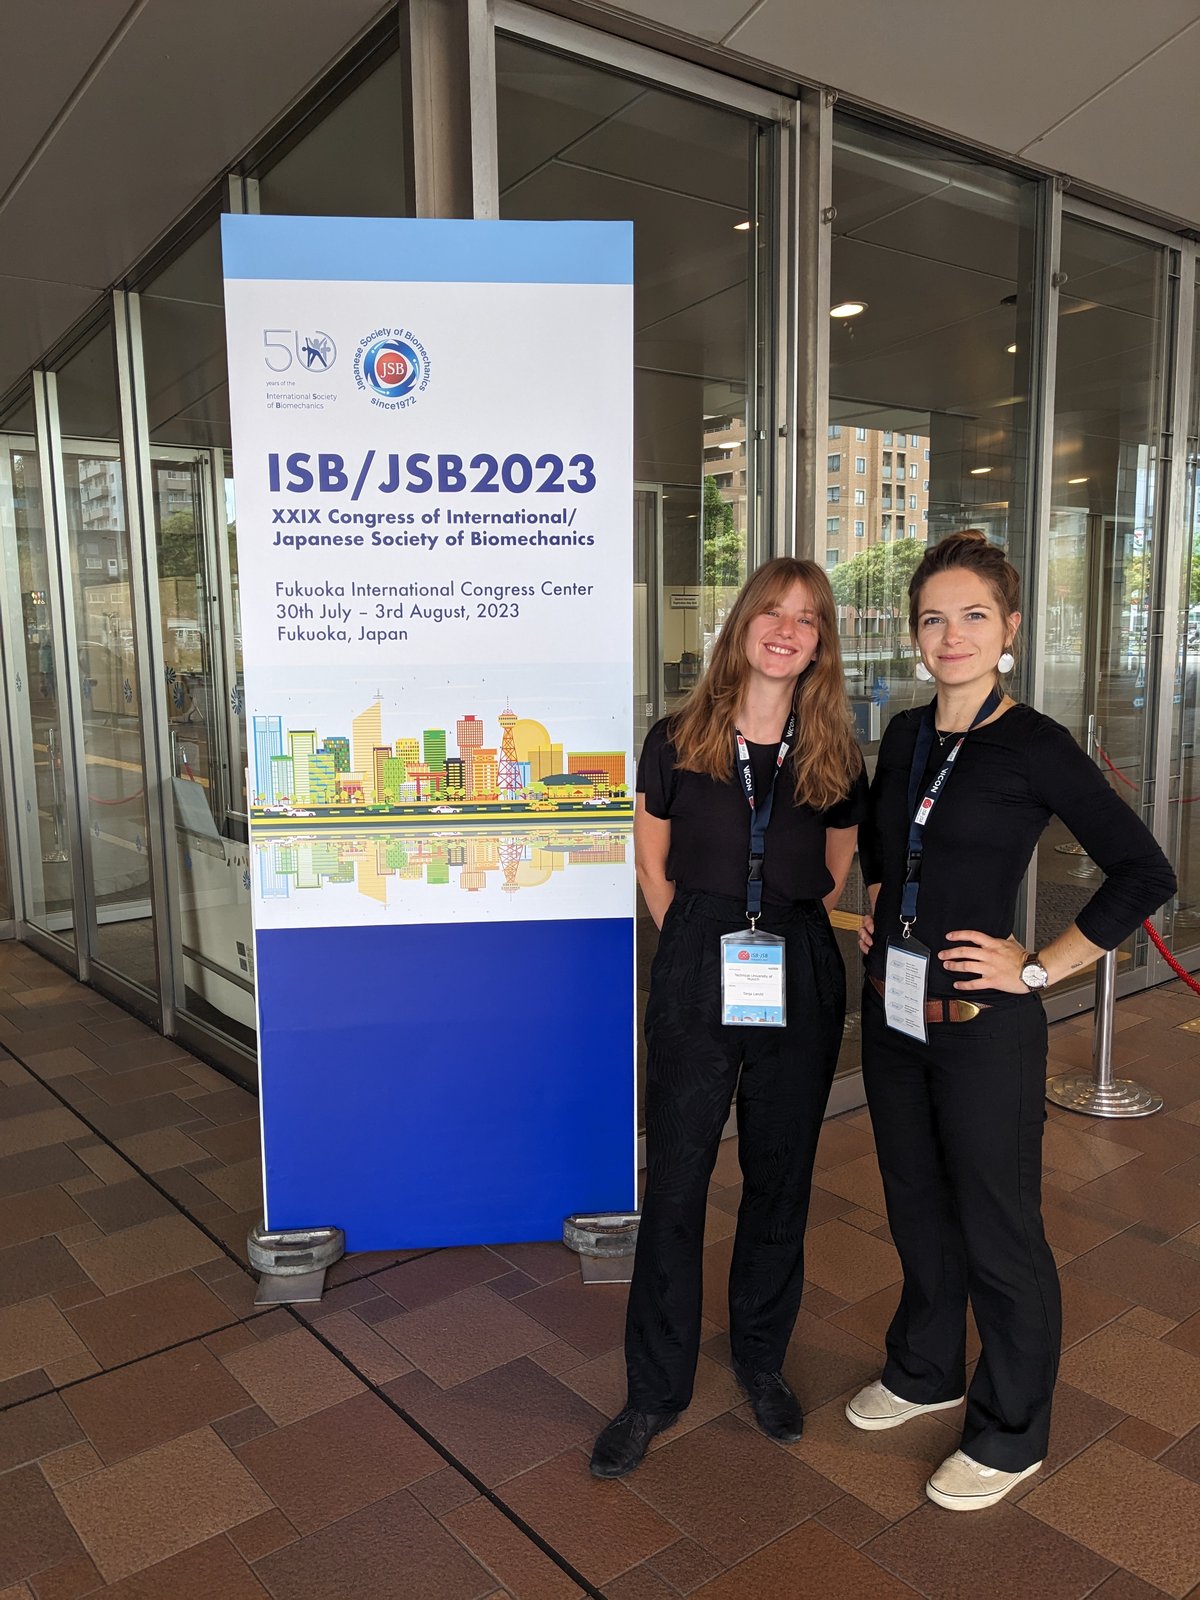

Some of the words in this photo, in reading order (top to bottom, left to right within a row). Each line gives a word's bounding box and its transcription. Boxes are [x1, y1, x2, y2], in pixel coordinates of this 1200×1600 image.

[353, 347, 366, 391] Japanese
[360, 328, 391, 347] Society
[394, 328, 403, 336] of
[404, 330, 432, 392] Biomechanics
[381, 362, 405, 378] JSB
[266, 392, 311, 400] International
[312, 392, 338, 401] Society
[275, 402, 324, 410] Biomechanics
[370, 395, 417, 410] since1972
[268, 450, 597, 501] ISB/JSB2023
[272, 509, 321, 524] XXIX
[328, 508, 415, 529] Congress
[421, 508, 441, 524] of
[447, 508, 577, 526] International/
[272, 531, 364, 550] Japanese
[371, 530, 439, 551] Society
[445, 530, 465, 547] of
[471, 530, 595, 547] Biomechanics
[276, 580, 345, 597] Fukuoka
[352, 580, 454, 597] International
[461, 580, 535, 600] Congress
[541, 581, 594, 596] Center
[277, 603, 314, 619] 30th
[319, 603, 352, 623] July
[375, 603, 404, 619] 3rd
[409, 603, 470, 623] August,
[477, 603, 520, 619] 2023
[278, 625, 352, 644] Fukuoka,
[358, 626, 408, 645] Japan
[786, 716, 796, 738] VICON
[743, 765, 752, 791] VICON
[930, 768, 949, 793] VICON
